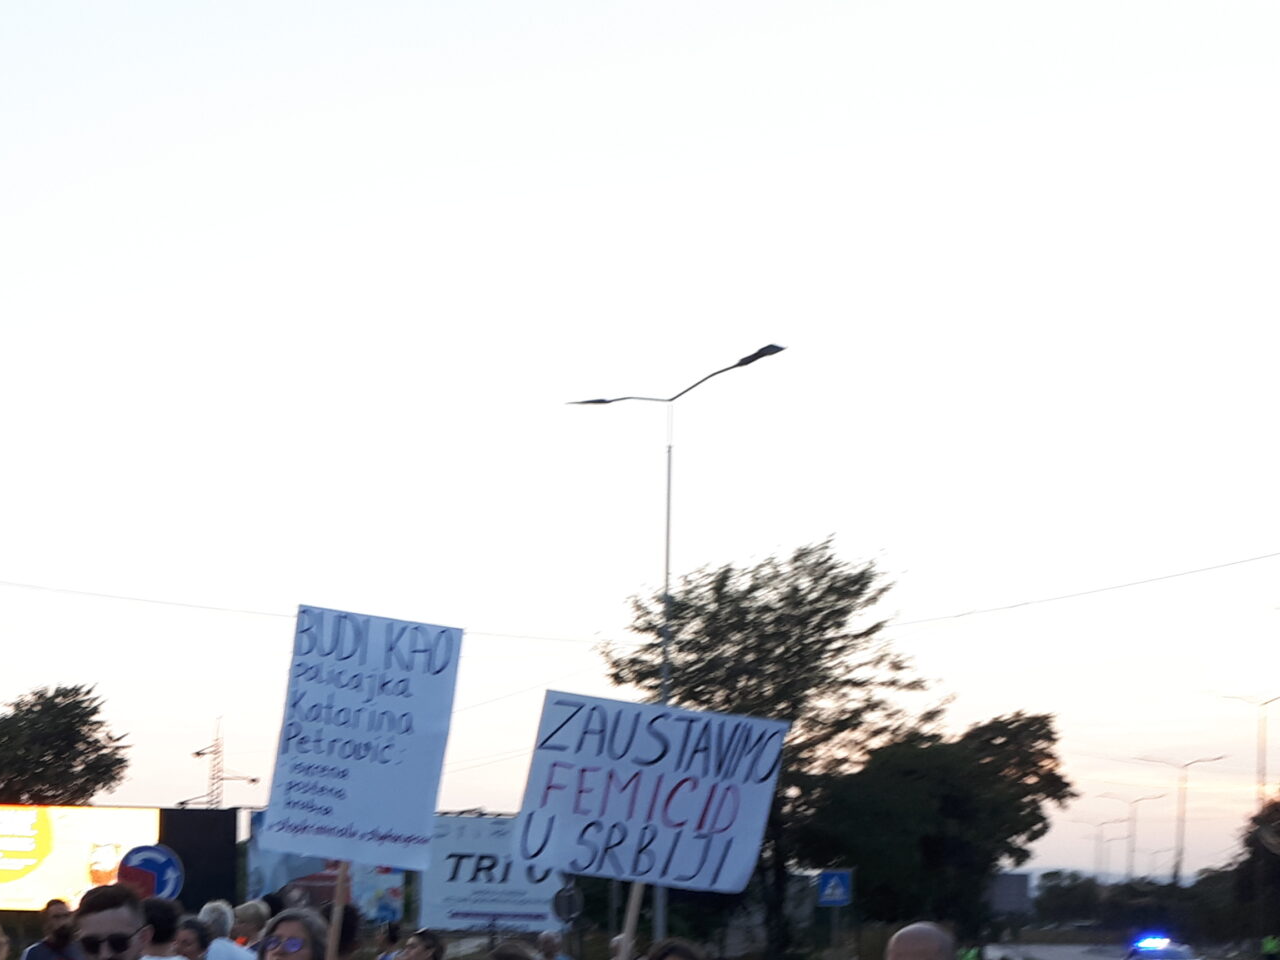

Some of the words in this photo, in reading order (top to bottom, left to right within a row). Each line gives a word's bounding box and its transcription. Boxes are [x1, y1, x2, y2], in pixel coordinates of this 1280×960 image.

[294, 608, 370, 666] BUDI
[383, 621, 455, 677] KAO
[537, 699, 783, 785] ZAUSTAVIMO
[538, 761, 742, 836] FEMICID
[521, 811, 556, 861] U
[570, 819, 735, 888] SRBIJI
